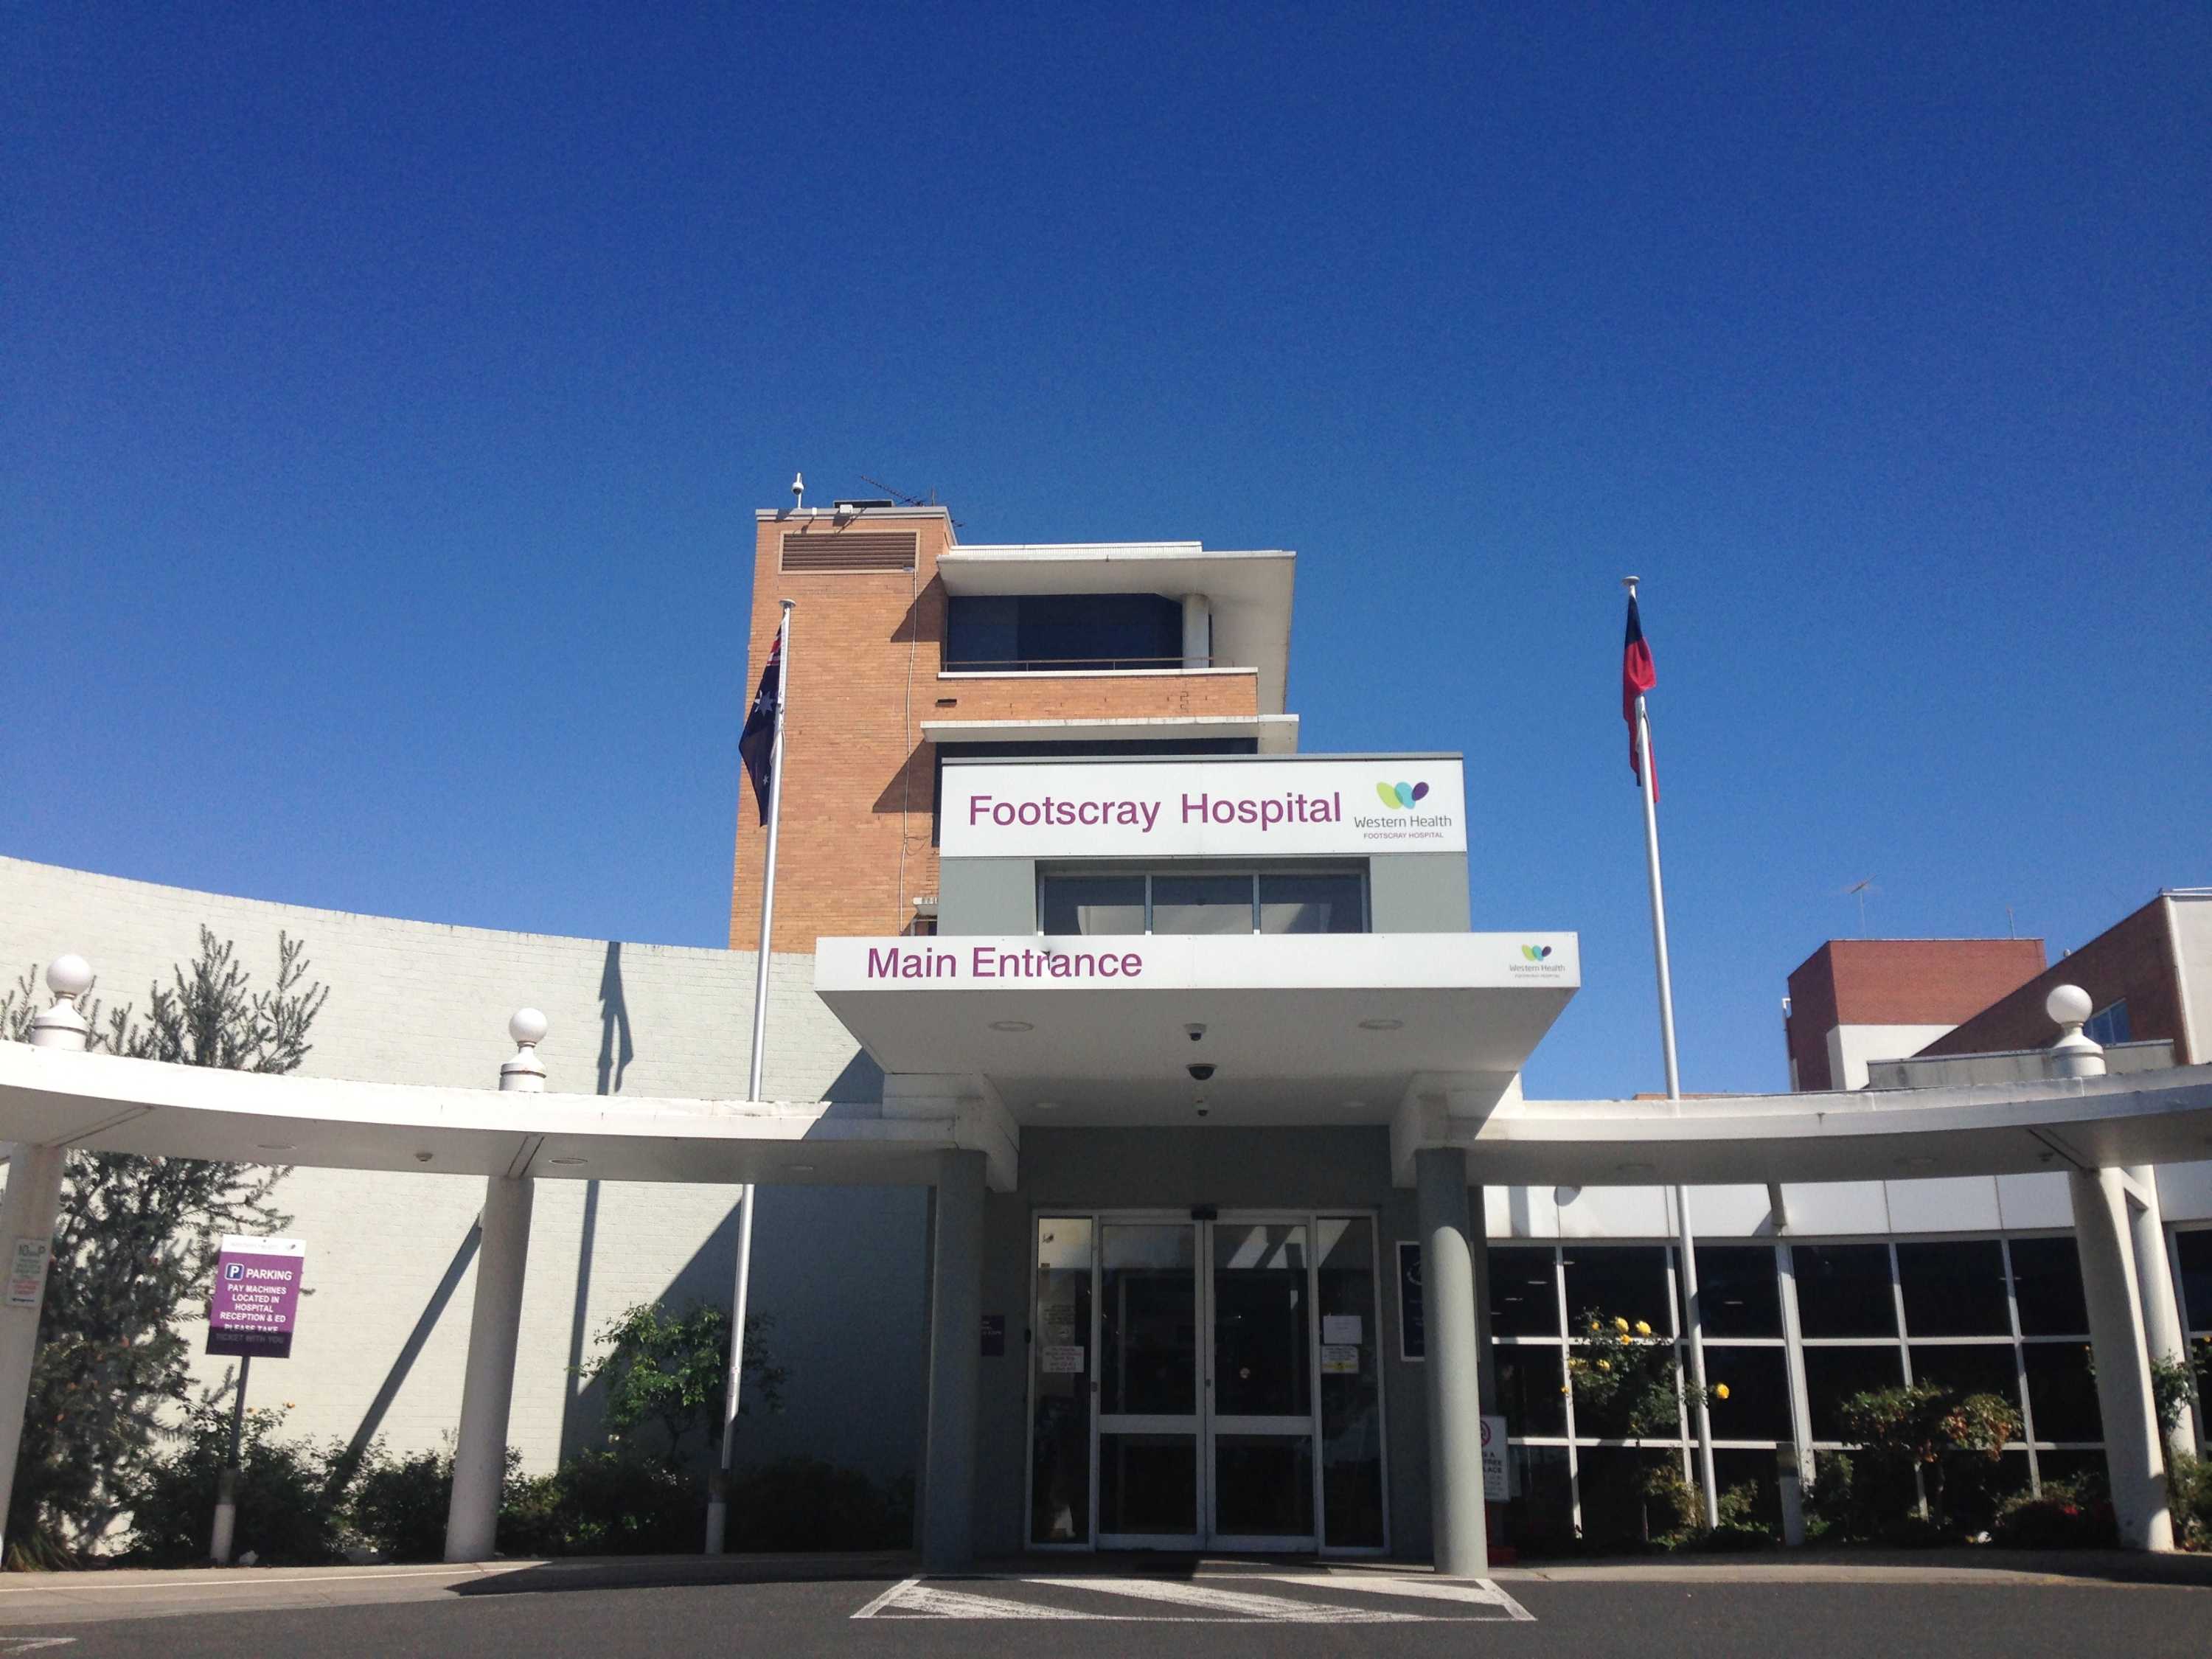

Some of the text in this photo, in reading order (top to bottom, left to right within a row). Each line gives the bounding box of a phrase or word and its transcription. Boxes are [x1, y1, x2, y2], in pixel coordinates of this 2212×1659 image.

[970, 791, 1340, 833] Footscray Hospital
[1354, 815, 1452, 828] Western Health
[867, 947, 1143, 978] Main Entrance
[246, 1268, 292, 1281] PARKING
[227, 1284, 288, 1295] PAY MACHINES
[232, 1294, 270, 1304] LOCATED
[234, 1303, 274, 1312] HOSPITAL
[220, 1312, 266, 1322] RECEPTION
[224, 1324, 255, 1332] PLEASE
[246, 1335, 266, 1343] WITH
[268, 1335, 284, 1344] YOU
